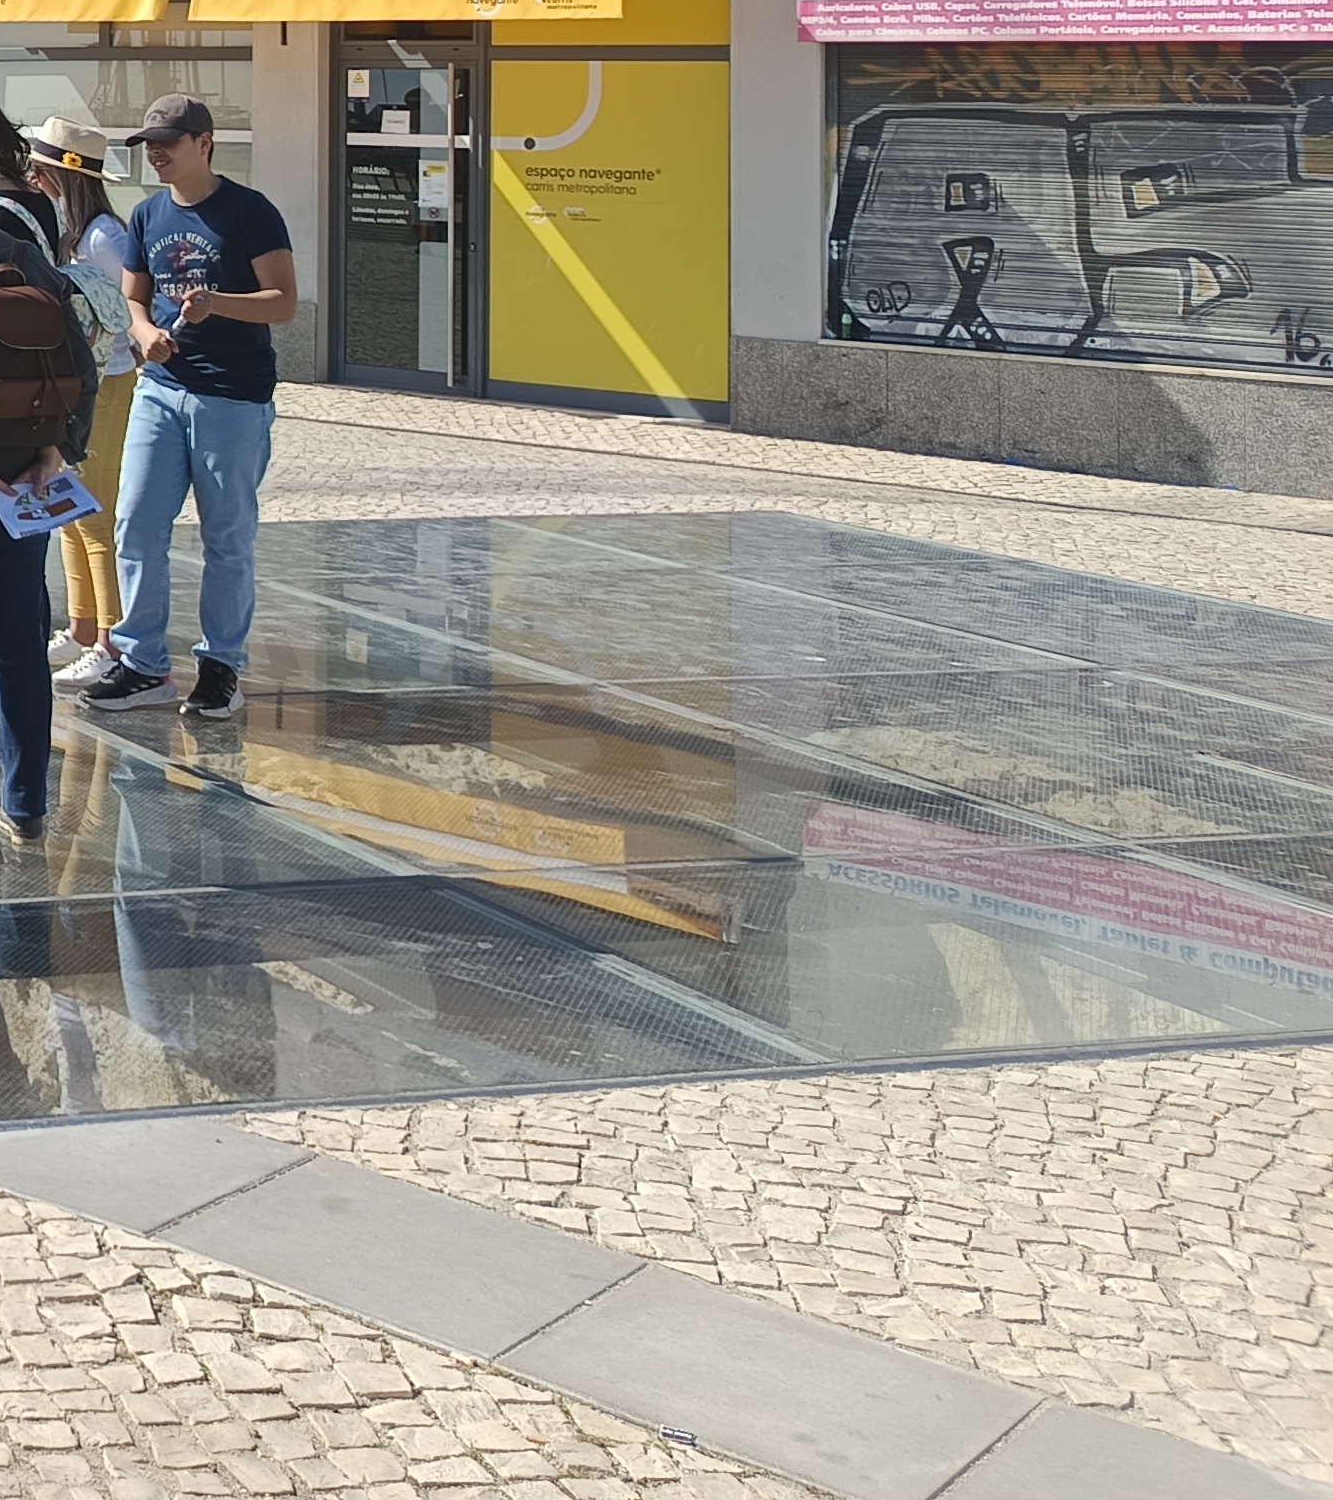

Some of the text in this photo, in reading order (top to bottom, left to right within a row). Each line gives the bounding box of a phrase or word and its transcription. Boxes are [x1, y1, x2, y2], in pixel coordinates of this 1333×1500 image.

[881, 2, 913, 11] Cabos
[983, 0, 1058, 12] Carregadores
[525, 166, 575, 181] espaço
[525, 181, 636, 196] carris metropolitana
[148, 232, 222, 262] NAUTICAL HERITAGE
